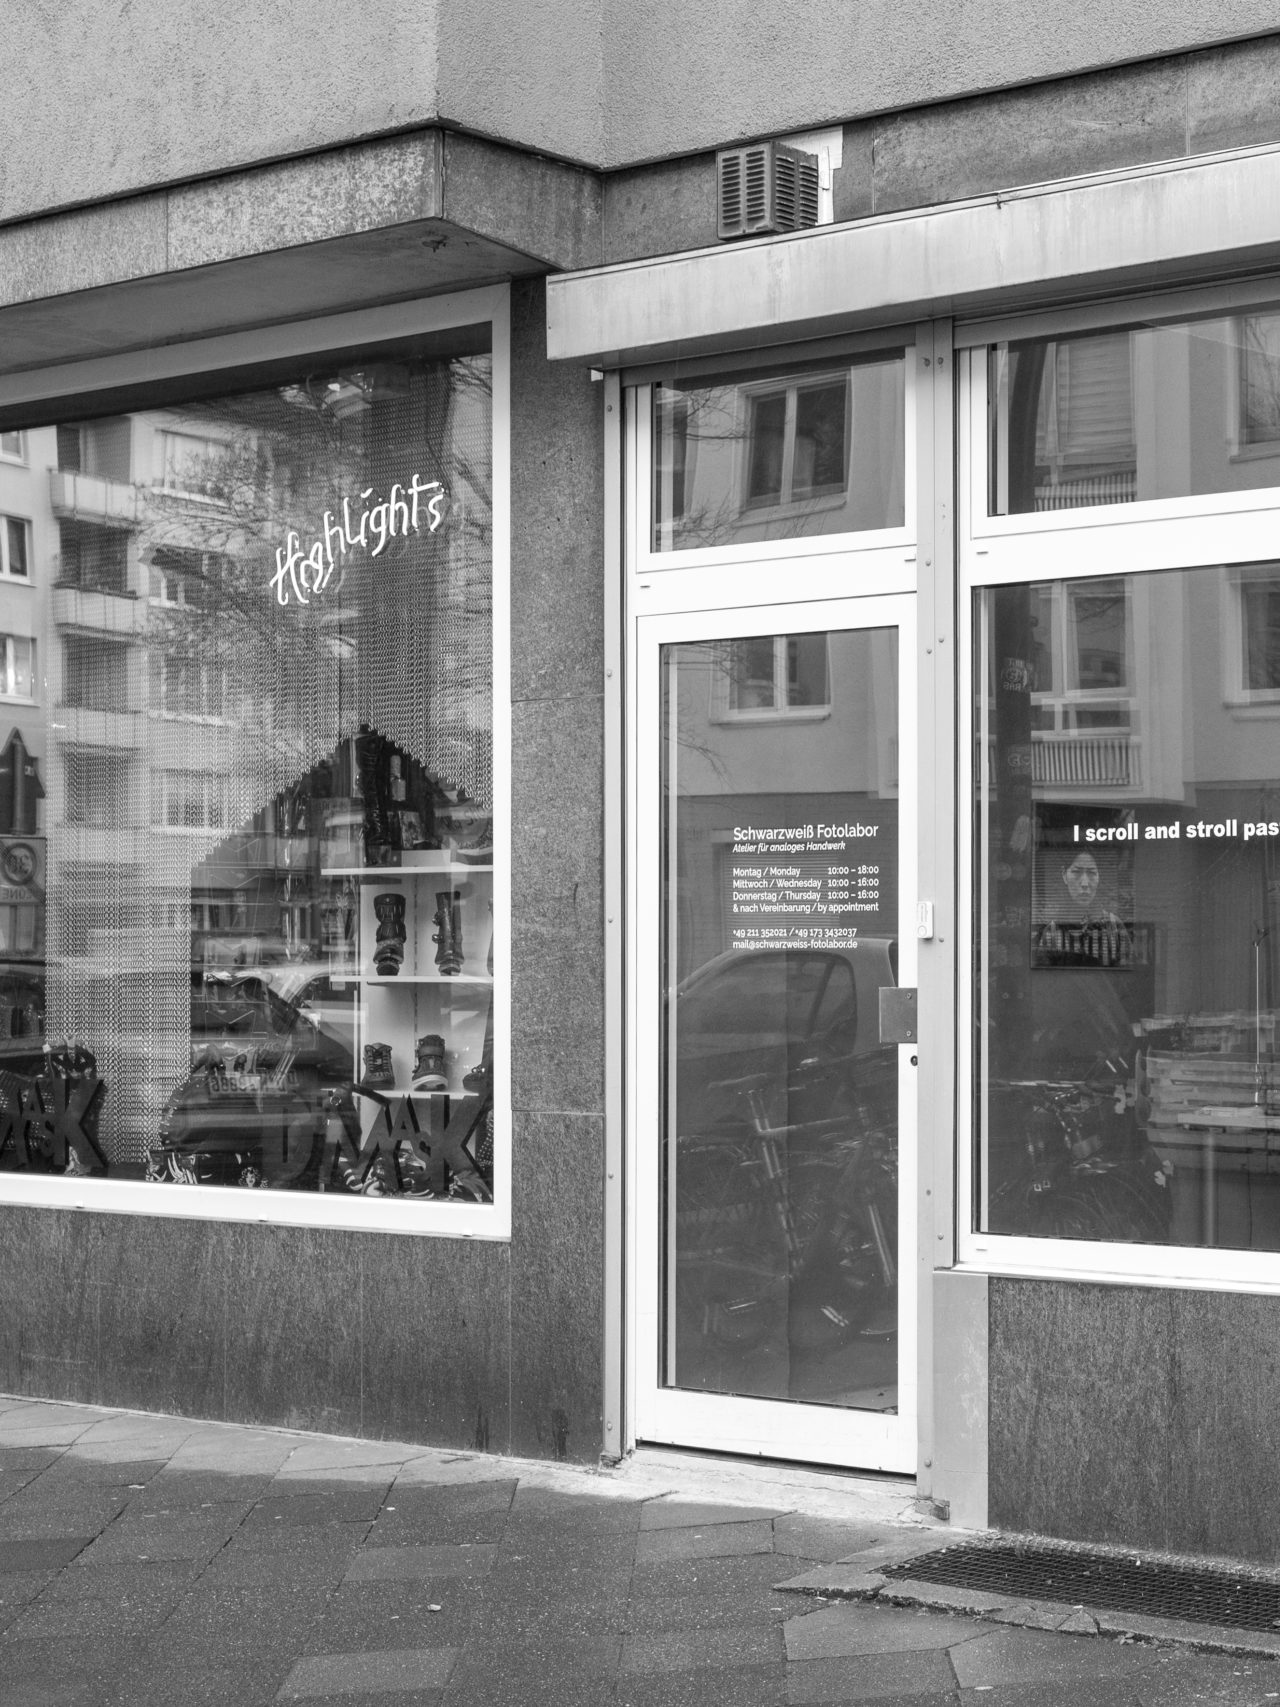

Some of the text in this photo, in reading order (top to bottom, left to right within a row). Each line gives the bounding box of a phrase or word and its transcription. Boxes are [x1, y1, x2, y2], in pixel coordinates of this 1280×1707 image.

[733, 823, 879, 841] Schwarzweiß Fotolabor
[1073, 825, 1079, 842] I
[1085, 823, 1139, 842] scroll
[1144, 821, 1180, 840] and
[1186, 819, 1238, 838] stroll
[733, 840, 846, 855] Atelier für analoges Handwerk
[733, 868, 761, 878] Montag
[769, 866, 801, 878] Monday
[828, 867, 849, 875] 10:00
[857, 865, 879, 875] 18:00
[733, 878, 768, 889] Mittwoch
[776, 878, 822, 890] Wednesday
[828, 879, 849, 887] 10:00
[857, 878, 879, 887] 16:00
[733, 891, 777, 902] Donnerstag
[785, 891, 821, 902] Thursday
[828, 891, 849, 899] 10:00
[857, 890, 879, 899] 16:00
[733, 904, 739, 912] &
[740, 903, 758, 912] nach
[759, 903, 811, 914] Vereinbarung
[818, 902, 828, 914] by
[828, 902, 879, 913] appointment
[747, 929, 759, 937] 211
[760, 929, 787, 938] 352021
[810, 929, 823, 938] 173
[824, 928, 857, 938] 3432037
[733, 939, 858, 950] mail@schwarzweiss-fotolabor.de
